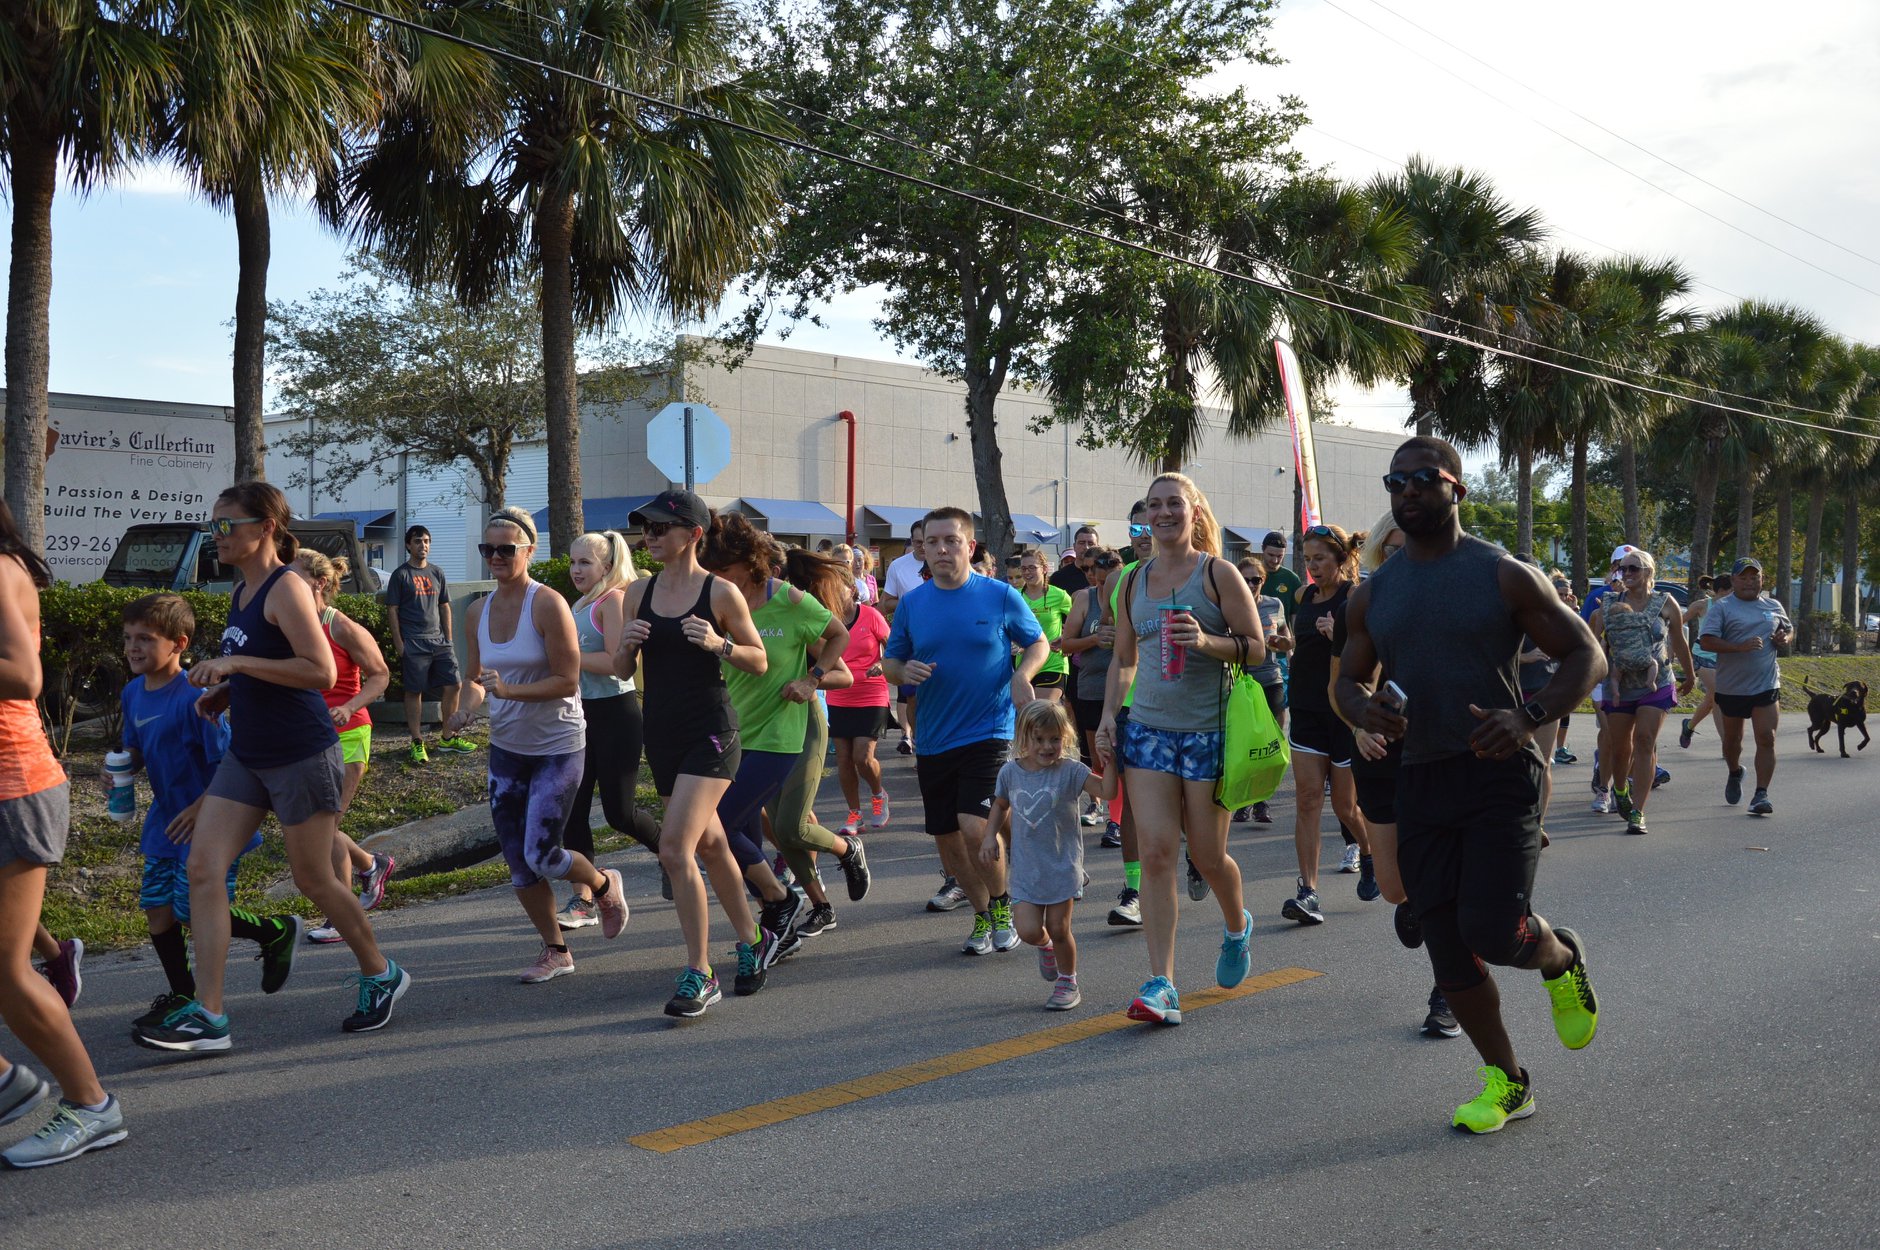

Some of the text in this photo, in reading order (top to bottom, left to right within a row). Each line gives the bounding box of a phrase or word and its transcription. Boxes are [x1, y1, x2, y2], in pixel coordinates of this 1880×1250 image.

[129, 431, 215, 455] Collection
[130, 454, 213, 472] Fine Cabinetry
[58, 485, 124, 500] Passion
[131, 489, 141, 501] &
[148, 490, 204, 505] Design
[43, 505, 208, 523] Build The Very Best
[1161, 616, 1169, 674] STARBUCKS
